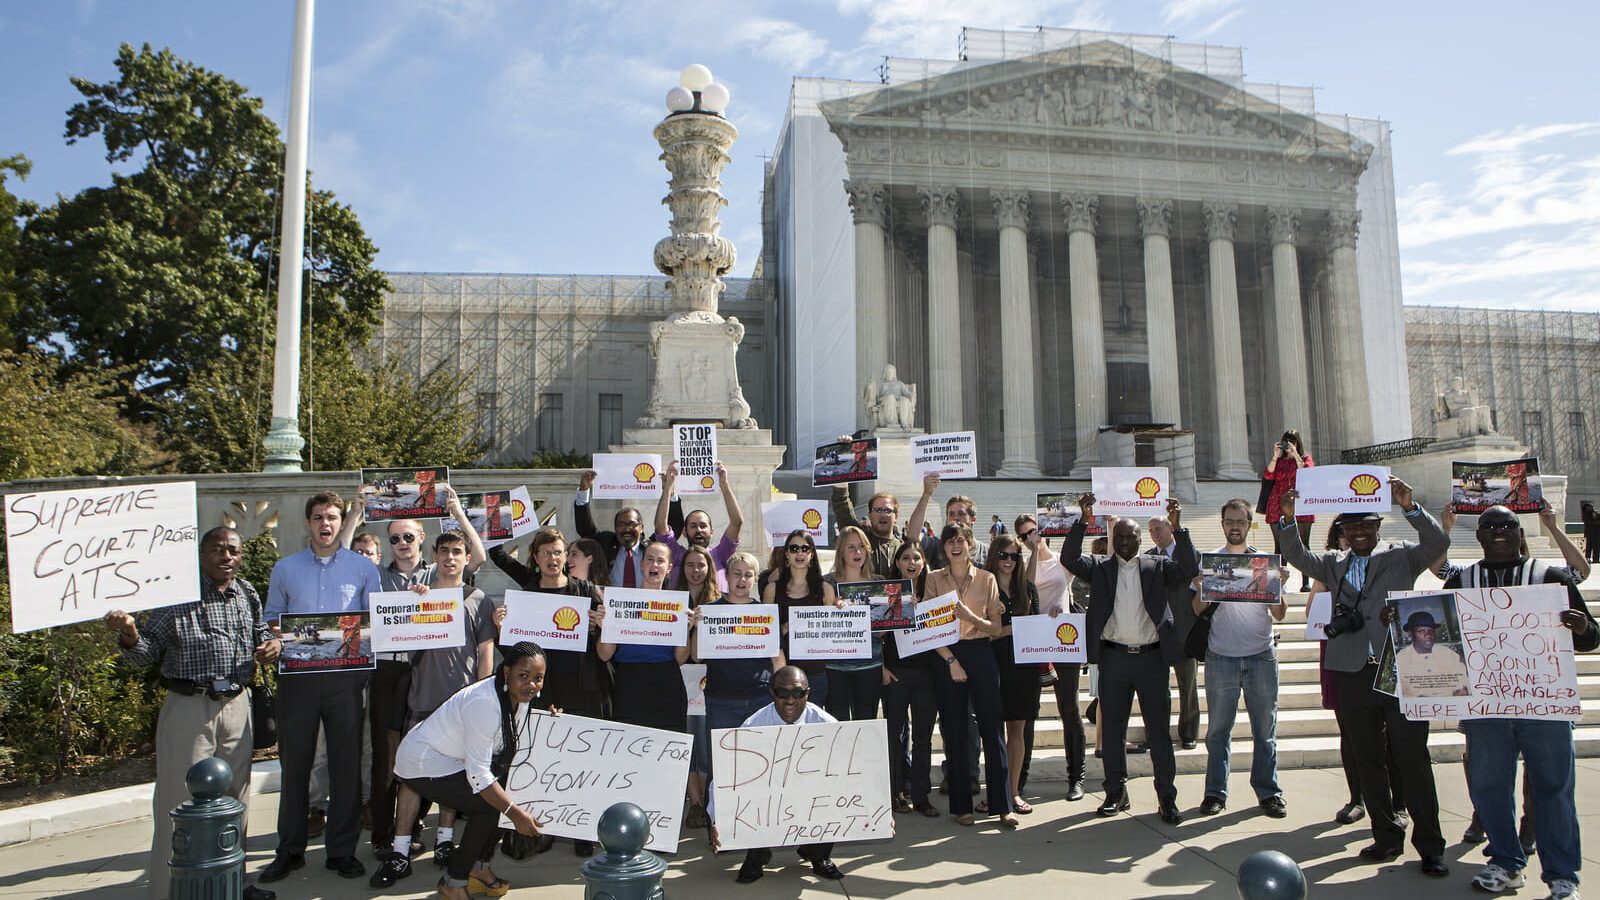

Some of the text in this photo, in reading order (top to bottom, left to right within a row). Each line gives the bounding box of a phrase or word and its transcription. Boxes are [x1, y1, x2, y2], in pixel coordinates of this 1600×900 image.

[680, 426, 711, 440] STOP
[941, 436, 971, 444] anywhere
[680, 447, 713, 457] HUMAN
[934, 445, 952, 453] threat
[680, 457, 713, 467] RIGHTS
[680, 466, 714, 476] ABUSES!
[1304, 496, 1382, 505] #ShameOnShell
[10, 489, 157, 538] SUPREME
[609, 599, 680, 611] Corporate Murder
[1455, 588, 1512, 614] NO
[376, 601, 454, 615] Corporate Murder
[394, 615, 410, 625] Still
[624, 610, 640, 619] Still
[703, 615, 771, 625] Corporate Murder
[830, 610, 866, 619] anywhere
[509, 628, 579, 640] #ShameOnShell
[718, 626, 733, 635] Still
[794, 631, 819, 639] justice
[1463, 632, 1516, 650] FOR
[1021, 645, 1080, 653] #ShameOnShell
[1467, 650, 1536, 671] OGONI
[1478, 671, 1557, 686] MAIMED
[1475, 683, 1576, 700] STRANGLED
[1405, 703, 1459, 718] WERE
[1467, 699, 1524, 717] KILLED
[517, 713, 690, 761] JUSTICE FOR
[509, 761, 638, 793] OGONI IS
[808, 795, 864, 821] FOR
